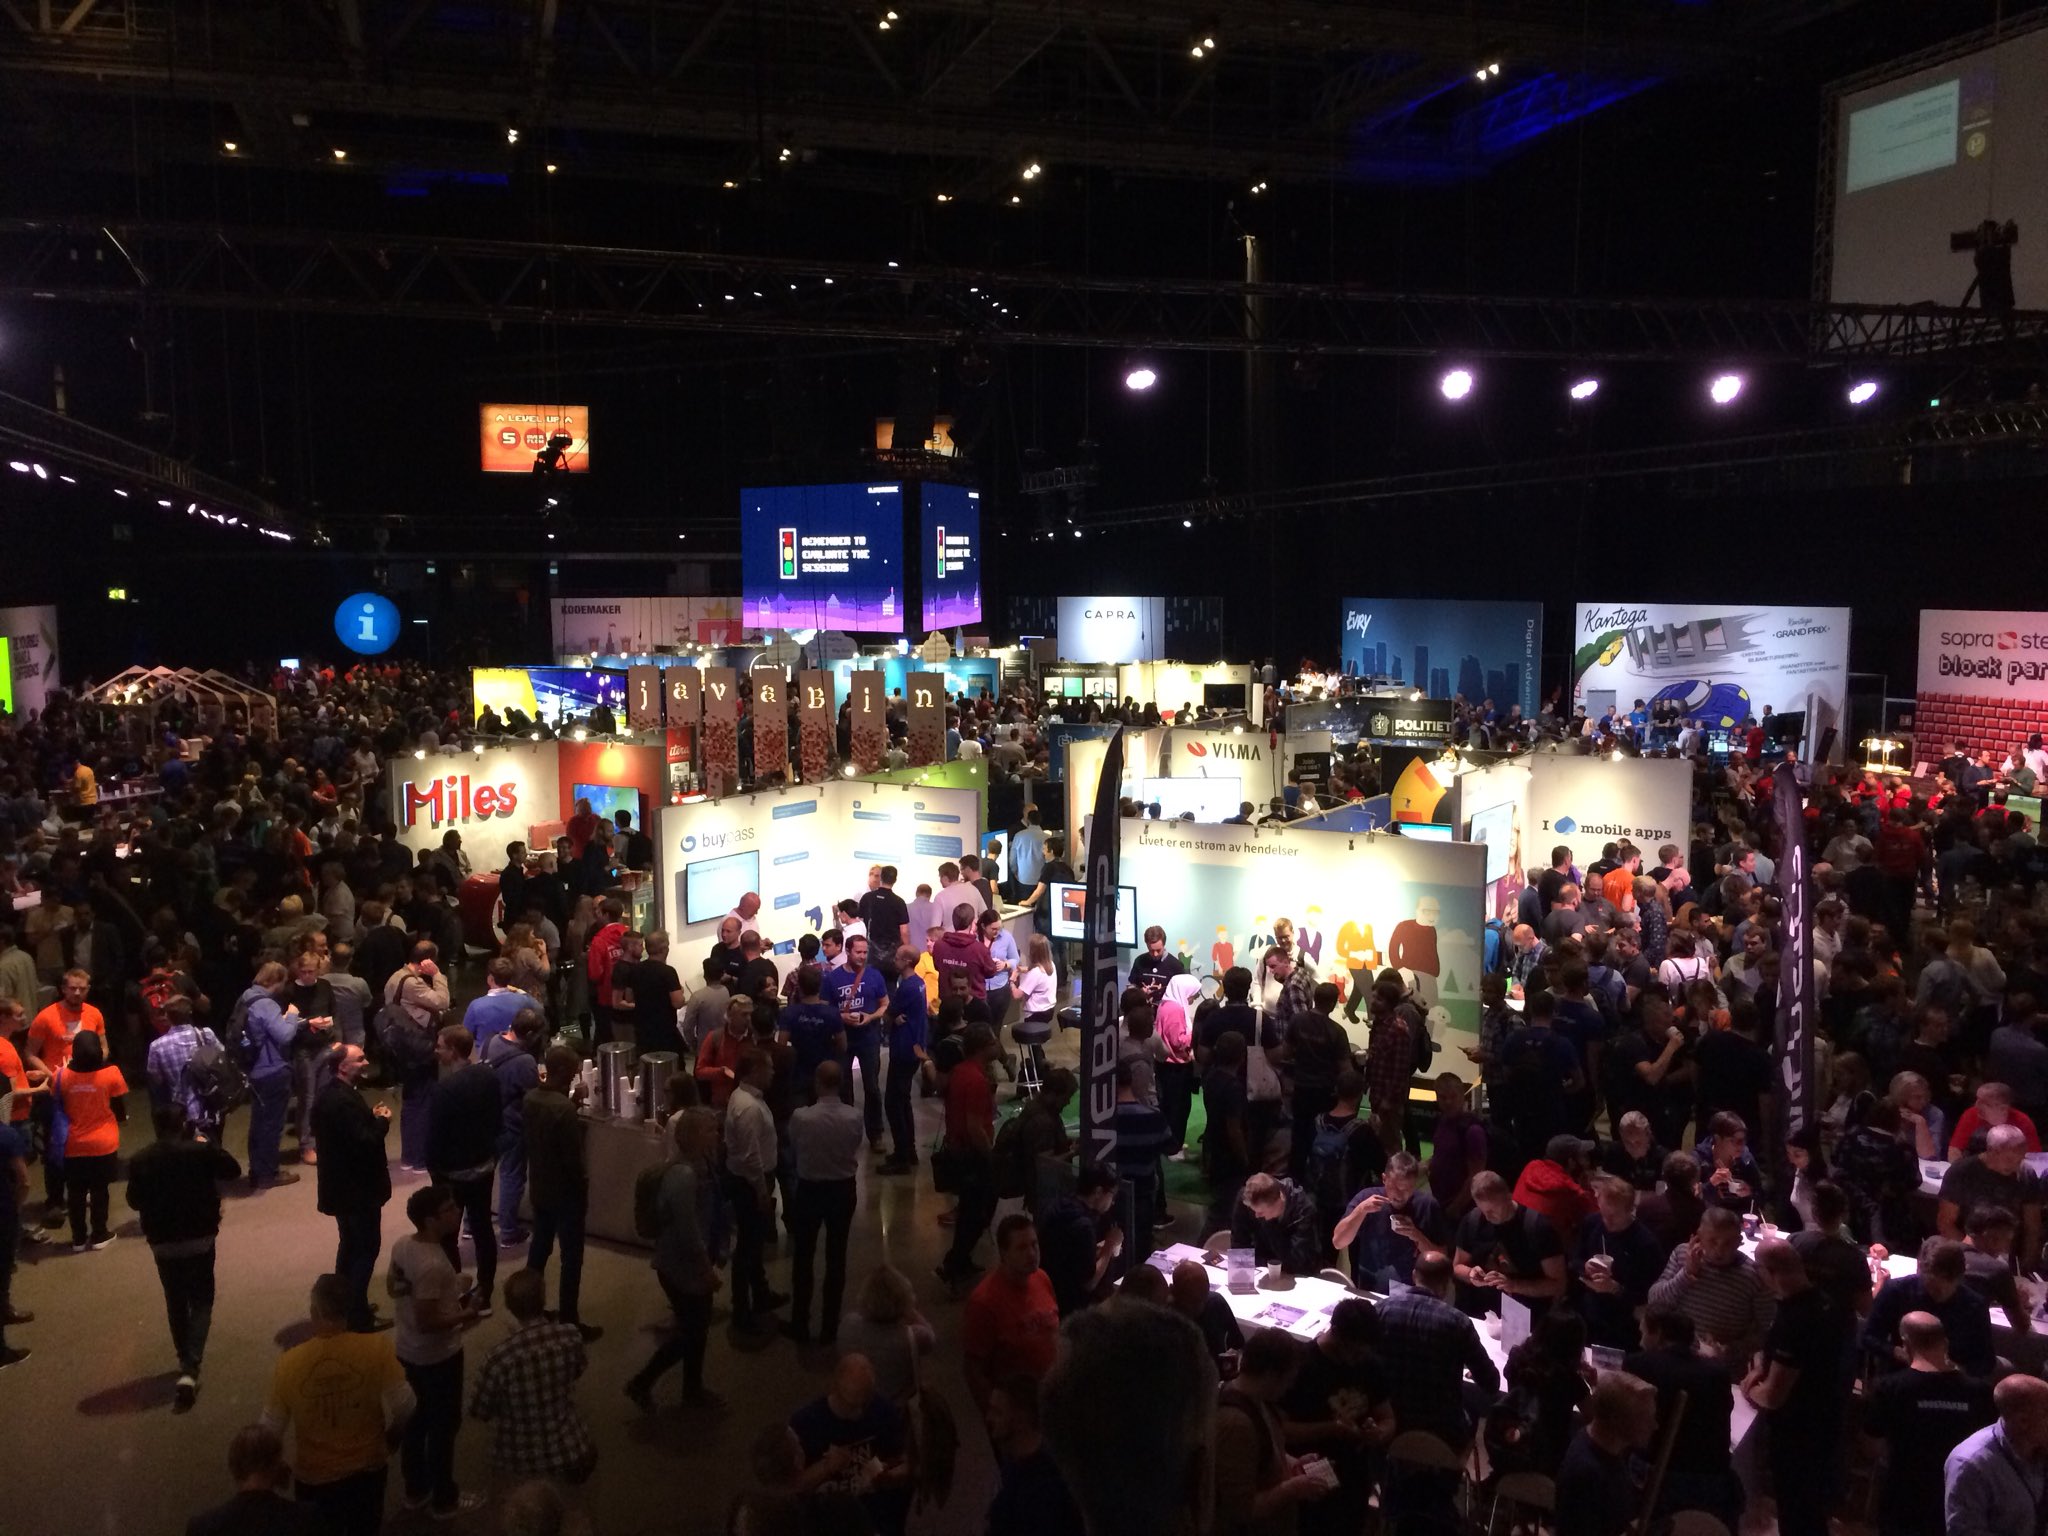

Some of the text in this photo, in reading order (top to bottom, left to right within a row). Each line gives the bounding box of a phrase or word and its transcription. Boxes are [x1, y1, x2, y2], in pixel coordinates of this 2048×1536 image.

[508, 414, 560, 423] LEVEL UP
[801, 535, 867, 547] REMEMBER TO
[561, 605, 621, 614] KODEMAKER
[1084, 609, 1136, 620] CAPRA
[1584, 606, 1648, 633] Kantega
[1525, 619, 1535, 658] Digital
[1776, 625, 1827, 639] GRAND PRIX
[1940, 631, 1994, 649] sopra
[1939, 653, 2002, 679] block
[1394, 719, 1452, 732] POLITIET
[1212, 742, 1262, 762] VISMA
[403, 774, 518, 829] Miles
[702, 826, 755, 849] buypass
[1542, 820, 1672, 841] I mobile apps
[1139, 835, 1299, 857] Livet er en strøm av hendelser
[839, 984, 862, 997] JON
